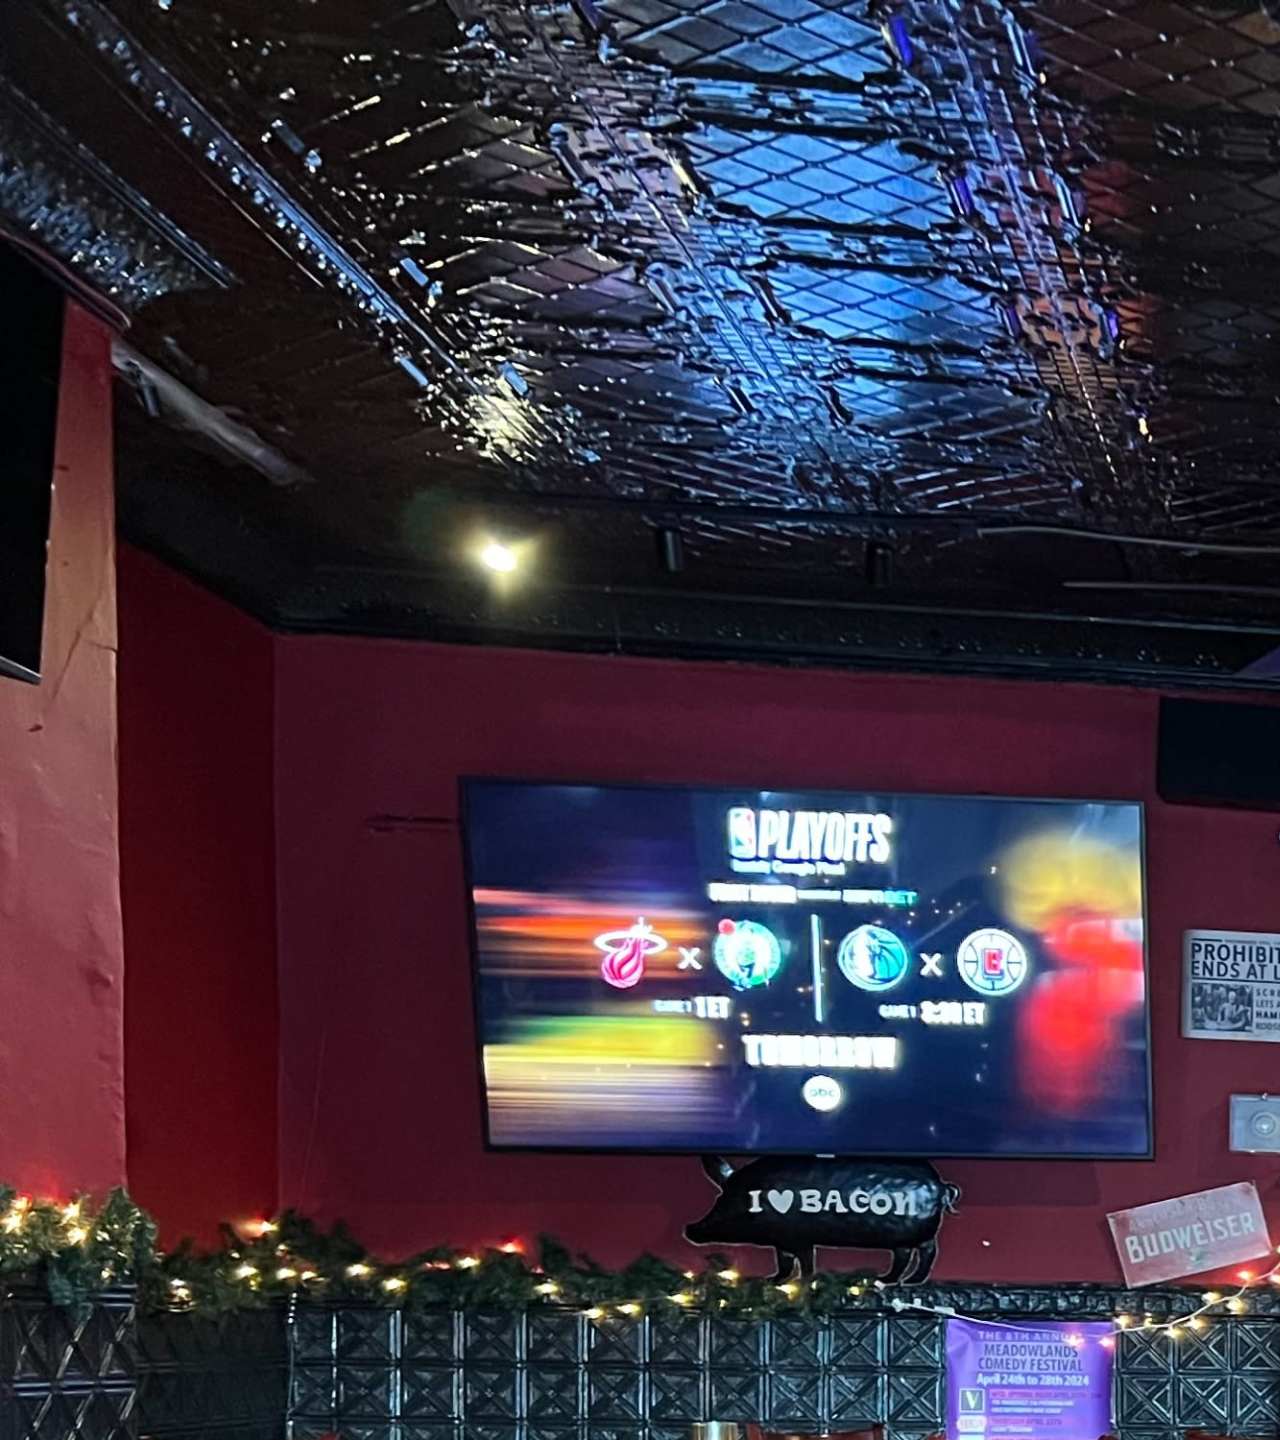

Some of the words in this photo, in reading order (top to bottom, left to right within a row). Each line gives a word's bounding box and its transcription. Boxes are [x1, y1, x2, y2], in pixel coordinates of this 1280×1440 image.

[758, 809, 892, 862] PLAYOFFS
[1192, 960, 1240, 978] ENDS
[1246, 964, 1267, 979] AT
[741, 1034, 897, 1069] TOMORROW
[748, 1190, 763, 1213] I
[800, 1187, 918, 1216] BACON
[1124, 1211, 1256, 1264] BUDWEISER
[977, 1330, 1001, 1341] THE
[984, 1344, 1078, 1358] MEADOWLANDS
[977, 1357, 1028, 1371] COMEDY
[1030, 1358, 1083, 1371] FESTIVAL
[976, 1372, 1001, 1387] April
[1001, 1373, 1026, 1385] 24th
[1027, 1375, 1038, 1385] to
[1063, 1375, 1089, 1386] 2024
